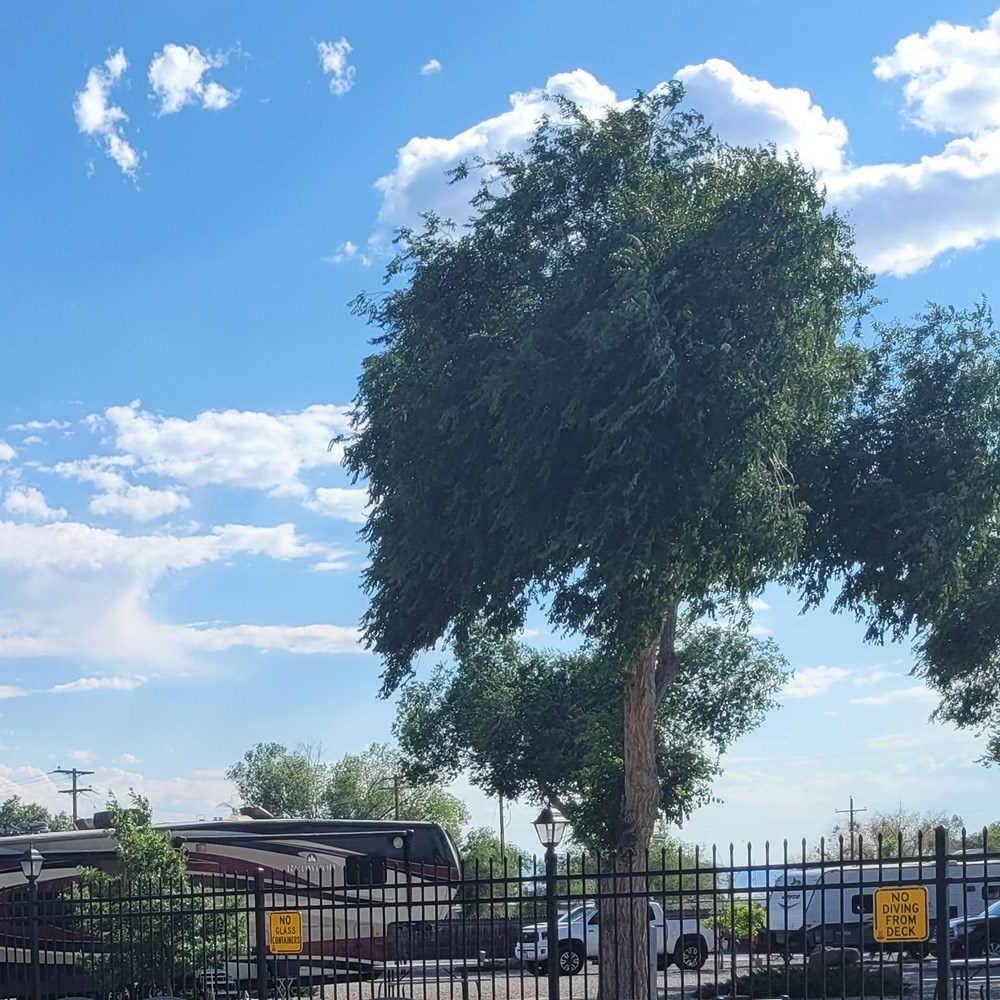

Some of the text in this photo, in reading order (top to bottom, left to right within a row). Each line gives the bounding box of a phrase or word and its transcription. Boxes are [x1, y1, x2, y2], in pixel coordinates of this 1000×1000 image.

[891, 892, 910, 902] NO
[882, 903, 920, 914] DIVING
[279, 915, 292, 925] NO
[885, 915, 917, 925] FROM
[275, 926, 296, 935] GLASS
[886, 926, 916, 937] DECK
[272, 936, 301, 945] CONTAINERS
